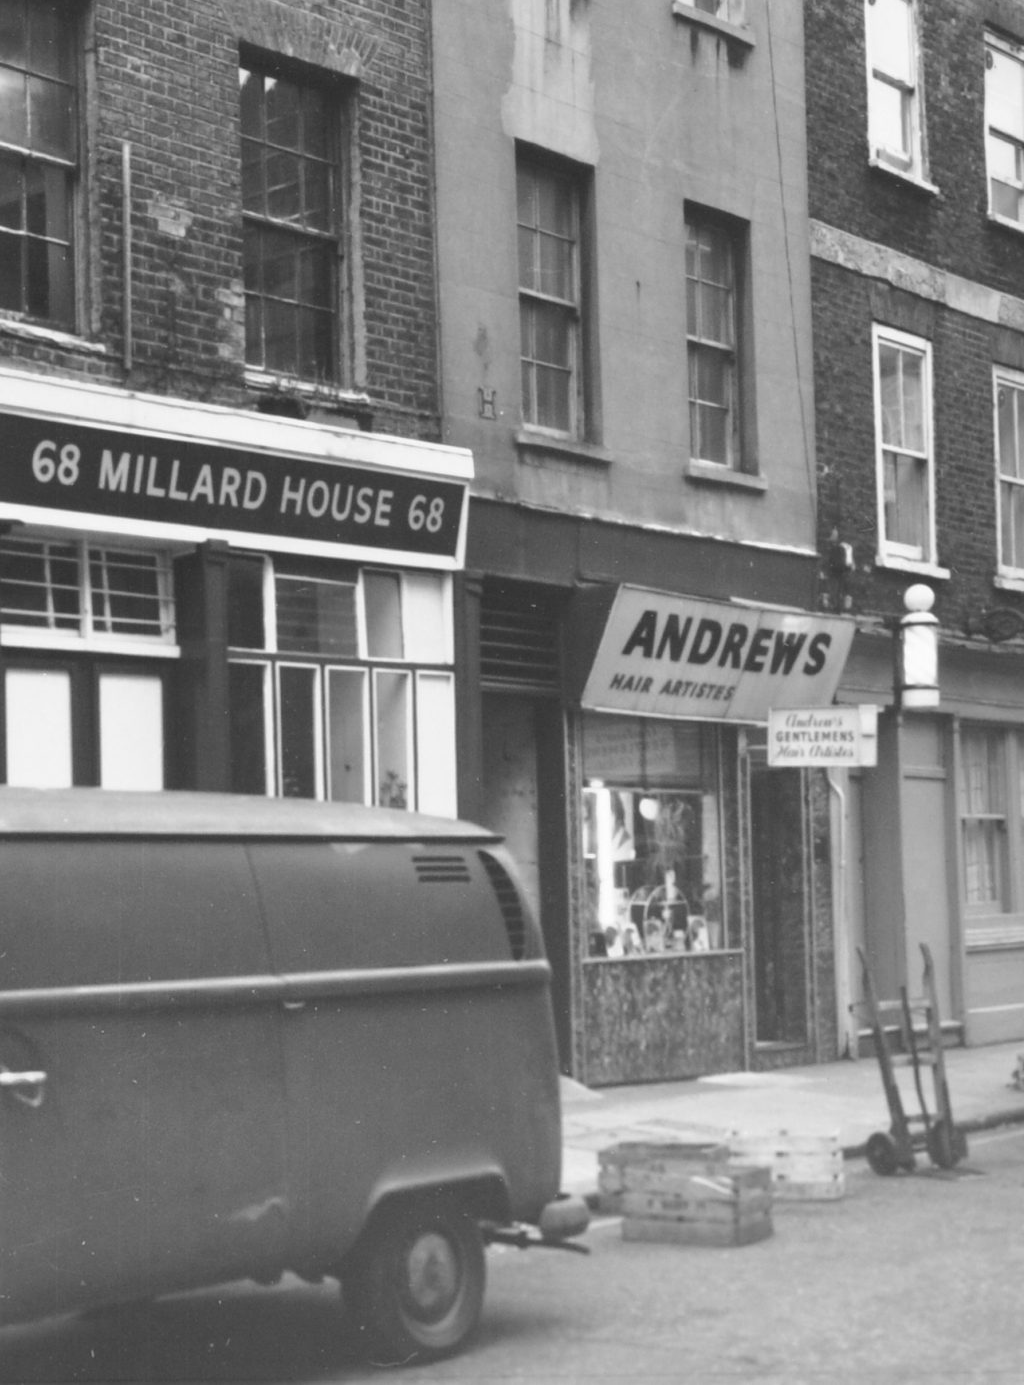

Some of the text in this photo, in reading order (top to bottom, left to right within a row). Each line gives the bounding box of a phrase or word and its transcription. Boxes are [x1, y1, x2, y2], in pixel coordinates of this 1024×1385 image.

[31, 440, 446, 533] 68 MILLARD HOUSE 68
[621, 609, 833, 676] ANDREWS
[609, 673, 736, 701] HAIR ARTISTES
[776, 730, 855, 743] GENTLEMENS
